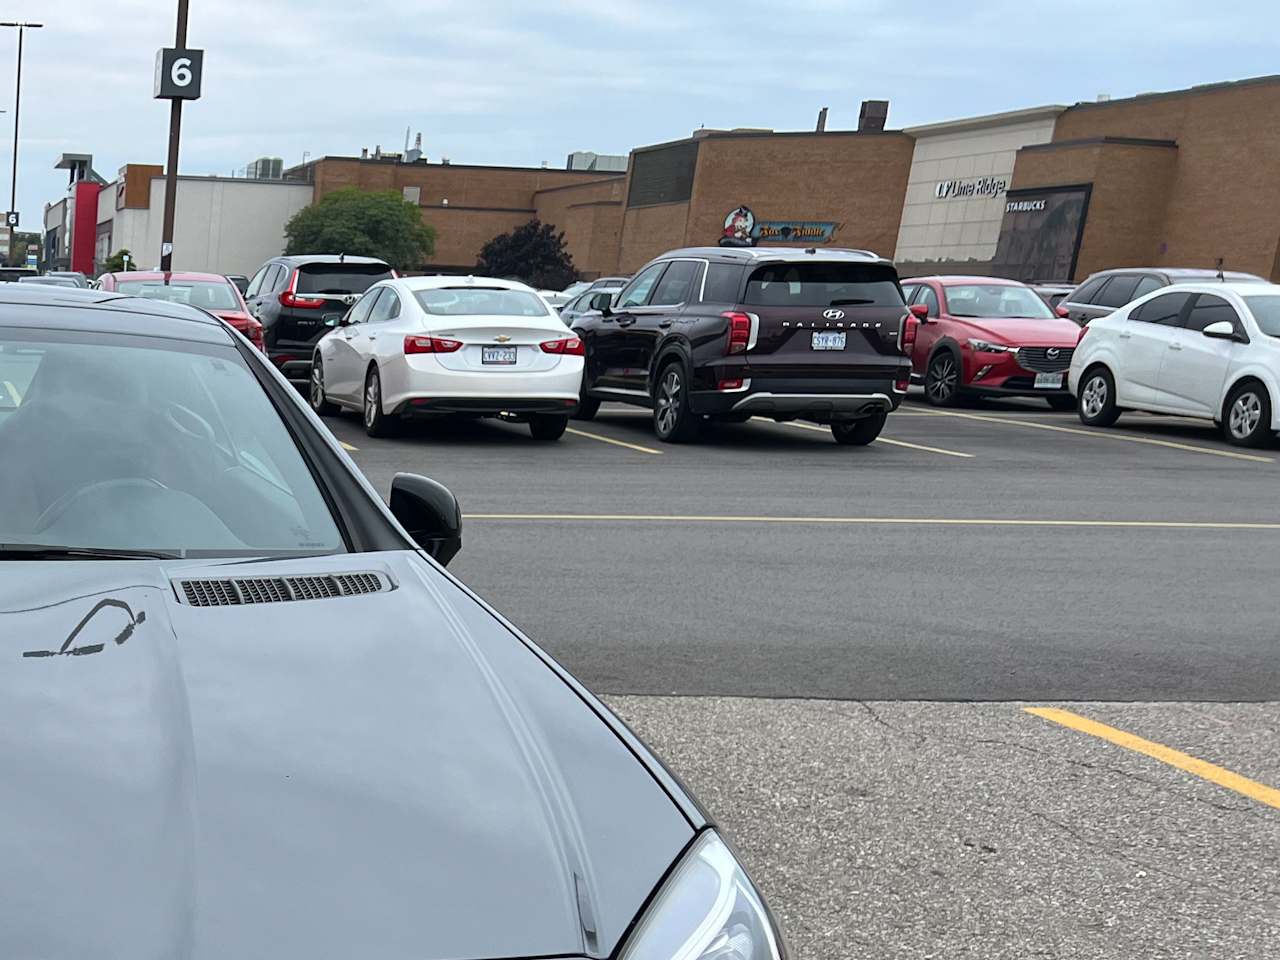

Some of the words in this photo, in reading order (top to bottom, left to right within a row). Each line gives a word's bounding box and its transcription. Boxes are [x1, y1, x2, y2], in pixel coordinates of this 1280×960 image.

[171, 58, 192, 87] 6
[952, 181, 975, 198] Lime
[977, 178, 1006, 199] Ridge
[1006, 200, 1047, 213] STARBUCKS
[8, 214, 17, 224] 6
[792, 226, 825, 238] Fiddle
